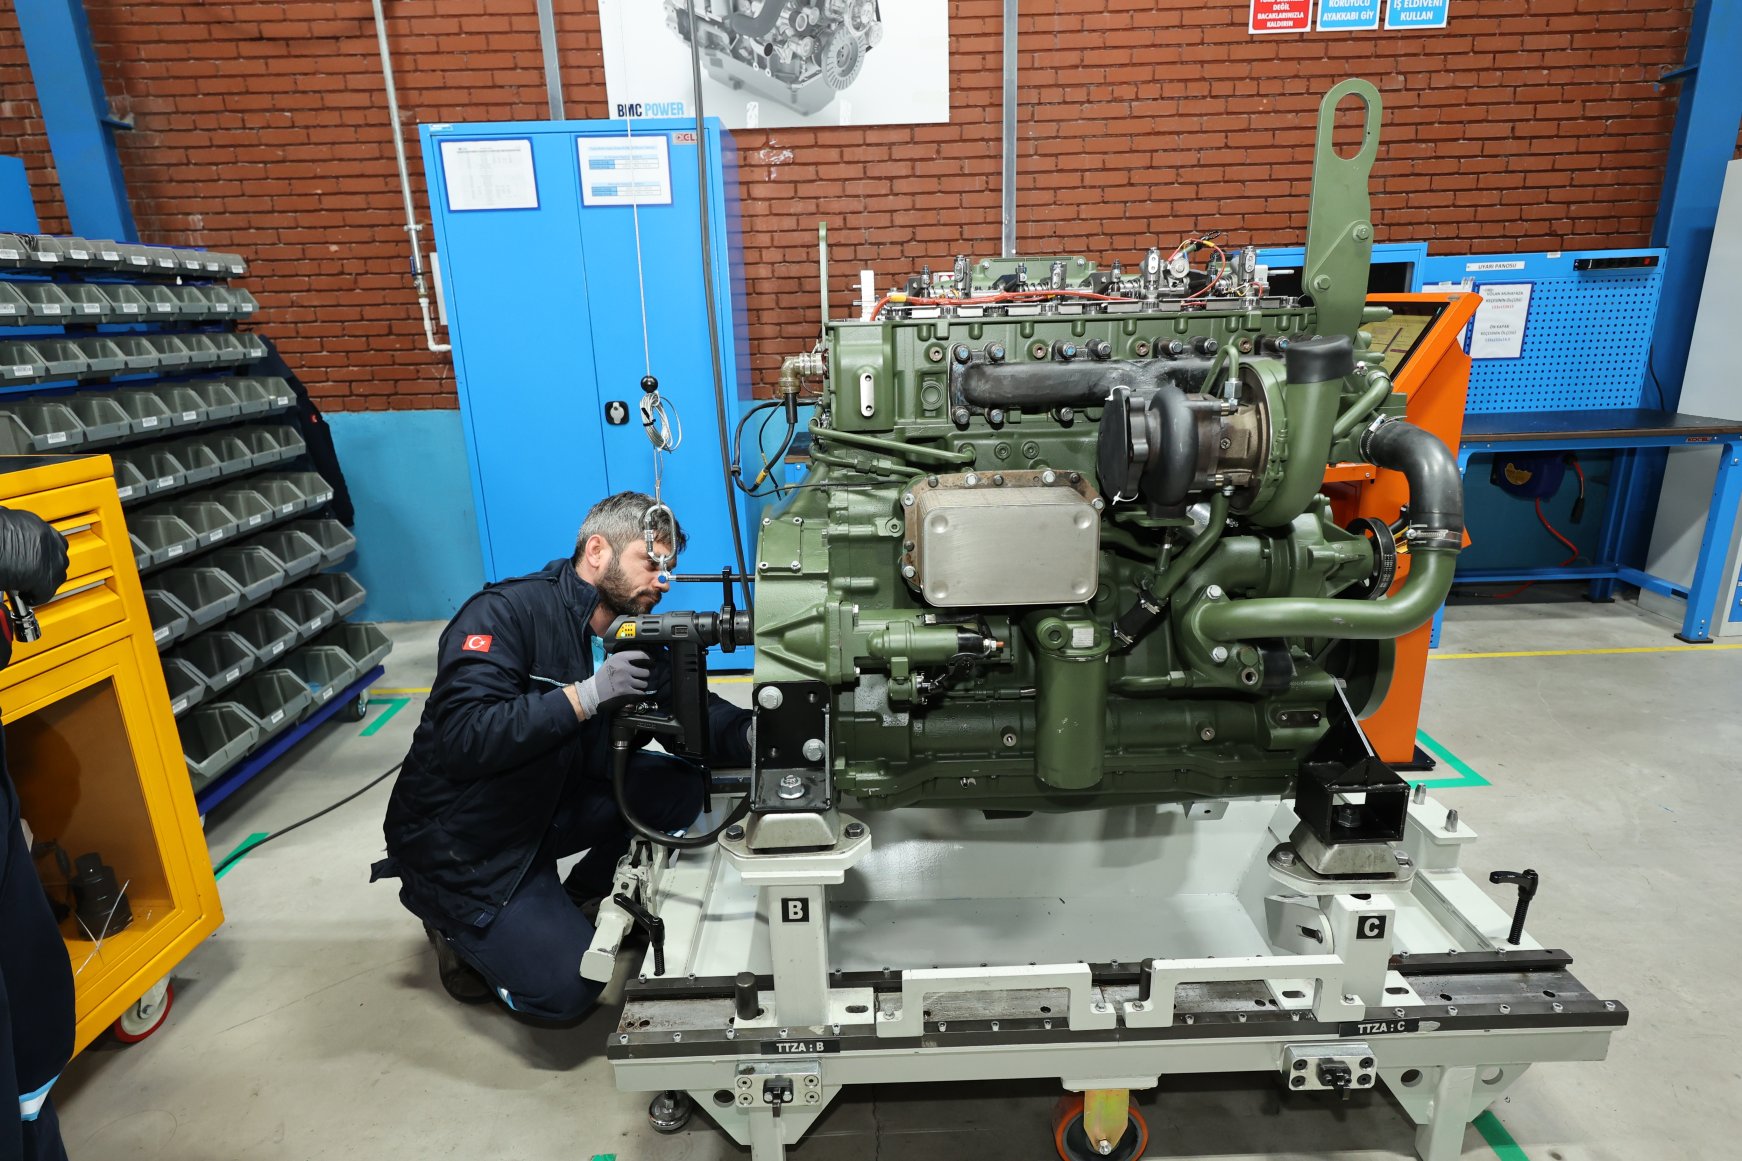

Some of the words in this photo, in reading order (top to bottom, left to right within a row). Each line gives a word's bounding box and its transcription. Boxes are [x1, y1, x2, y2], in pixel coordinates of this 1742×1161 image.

[1322, 11, 1359, 21] AYAKKABI
[1360, 9, 1375, 20] GİY
[1400, 11, 1434, 21] KULLAN
[617, 103, 643, 118] BMC
[644, 101, 684, 117] POWER
[788, 900, 803, 920] B
[1364, 917, 1380, 937] C
[1357, 1022, 1388, 1034] TTZA
[1397, 1021, 1406, 1031] C
[776, 1042, 807, 1053] TTZA
[816, 1041, 825, 1052] B
